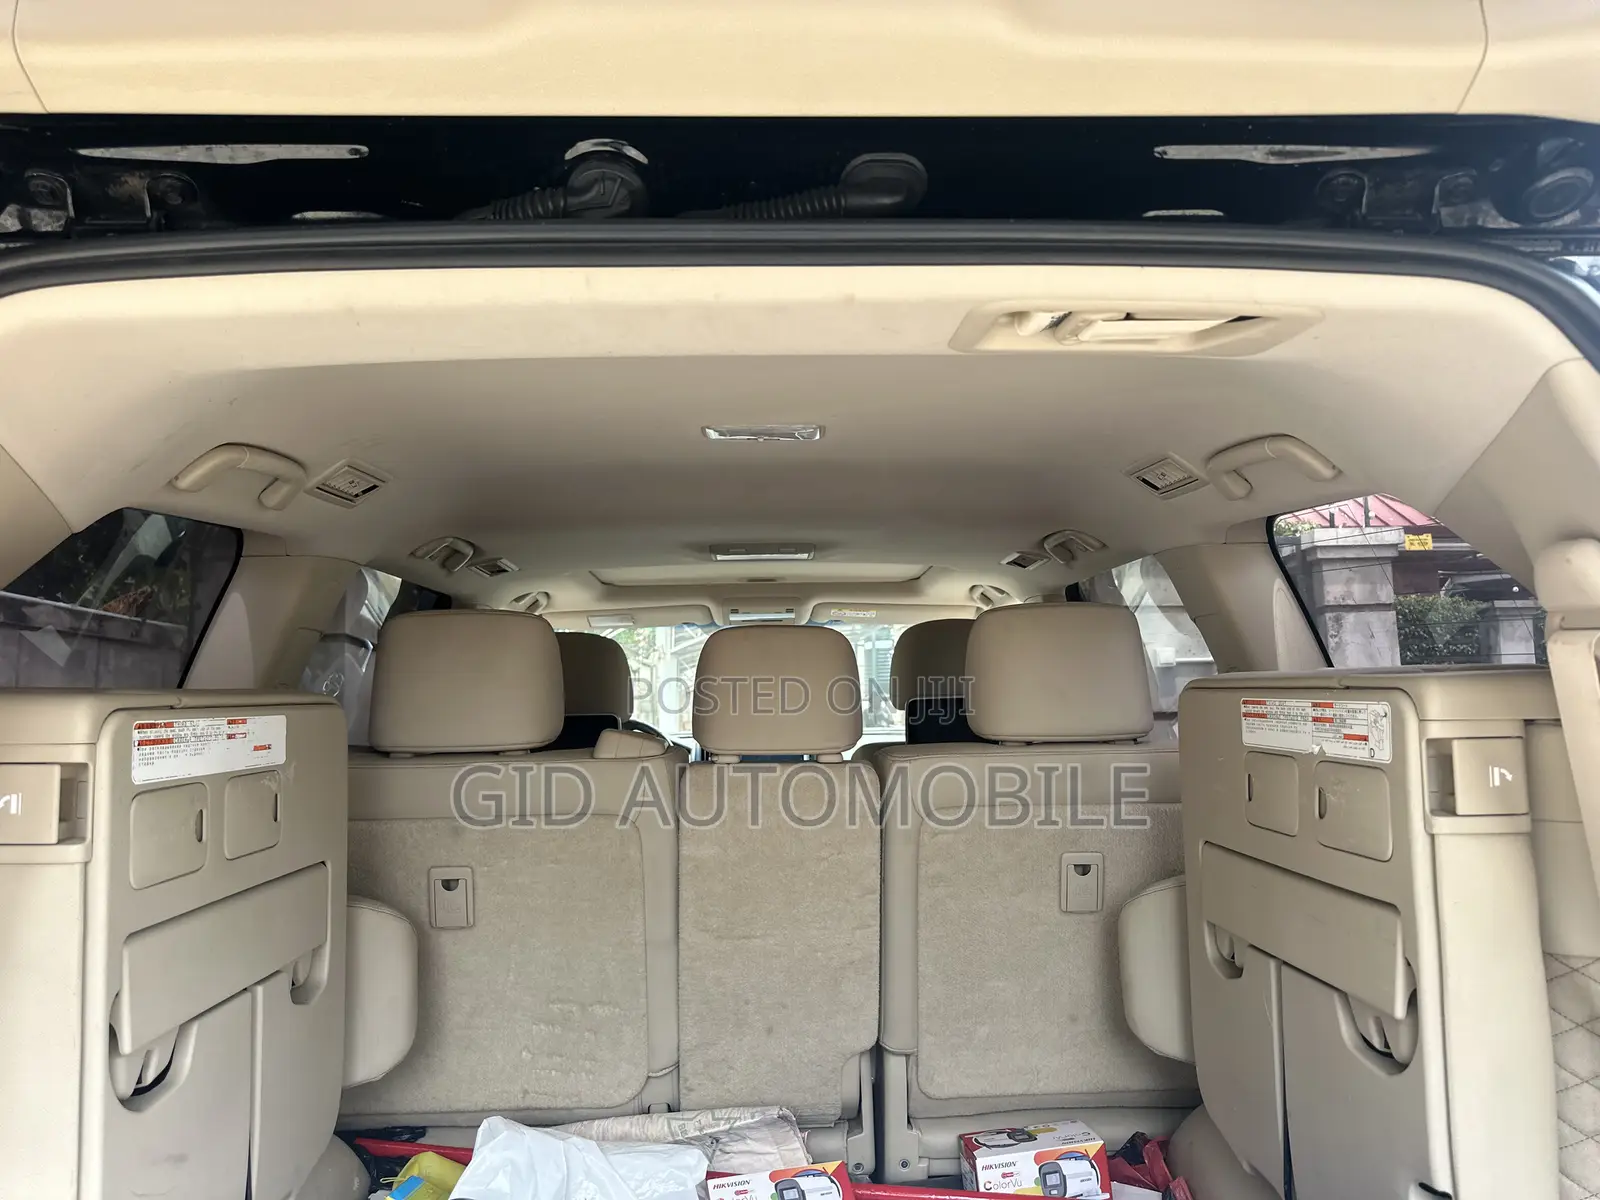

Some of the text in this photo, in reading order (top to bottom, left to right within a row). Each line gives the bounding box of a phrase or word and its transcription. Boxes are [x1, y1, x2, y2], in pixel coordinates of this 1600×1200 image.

[981, 1160, 1018, 1171] HIKVISION
[712, 1179, 752, 1190] HIKVISION
[983, 1178, 1023, 1191] ColorVu
